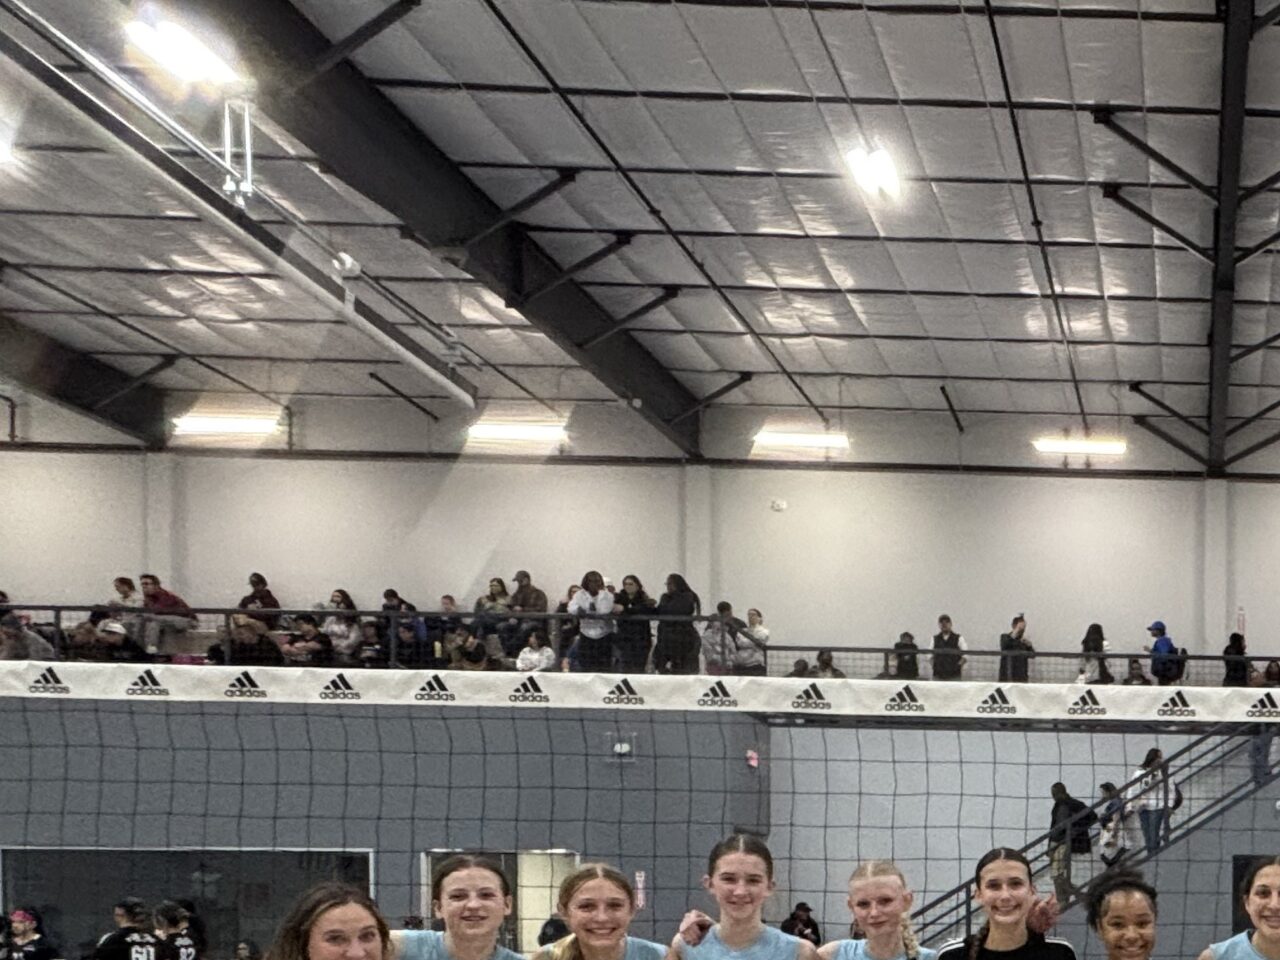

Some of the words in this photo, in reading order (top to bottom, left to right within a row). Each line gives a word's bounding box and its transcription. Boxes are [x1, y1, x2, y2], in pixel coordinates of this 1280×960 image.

[29, 684, 70, 694] adidas
[126, 686, 169, 696] adidas
[224, 688, 267, 698] adidas
[319, 690, 361, 700] adidas
[415, 691, 456, 701] adidas
[509, 693, 550, 703] adidas
[603, 694, 644, 705] adidas
[697, 696, 738, 707] adidas
[791, 699, 831, 710] adidas
[885, 701, 925, 712] adidas
[977, 703, 1016, 714] adidas
[1067, 705, 1106, 715] adidas
[1157, 706, 1196, 717] adidas
